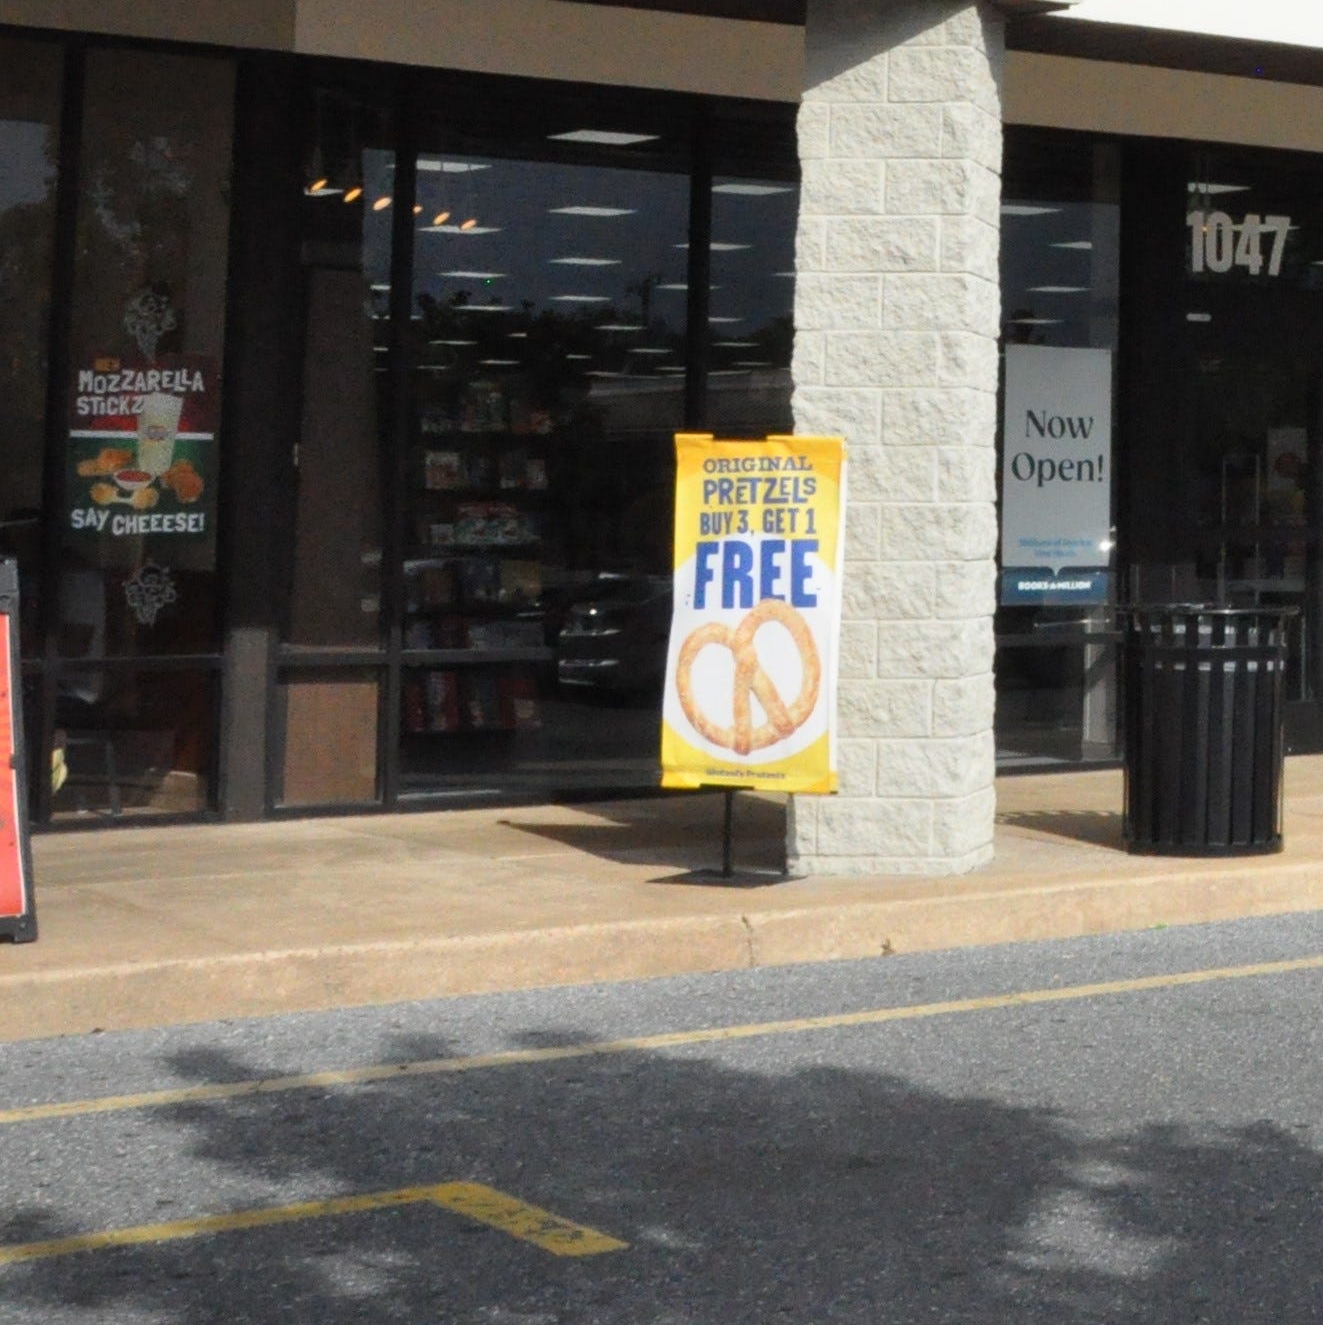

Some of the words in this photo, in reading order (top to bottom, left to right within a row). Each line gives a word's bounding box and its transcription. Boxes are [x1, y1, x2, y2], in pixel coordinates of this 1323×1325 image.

[1186, 211, 1291, 276] 1047
[78, 368, 205, 394] MOZZARELLA
[1024, 409, 1095, 439] Now
[702, 456, 813, 473] ORIGINAL
[1011, 451, 1104, 488] Open!
[703, 477, 817, 505] PRETZELS
[71, 507, 110, 532] SAY
[700, 512, 733, 536] BUY
[762, 508, 799, 535] GET
[805, 507, 817, 534] 1
[693, 538, 819, 610] FREE
